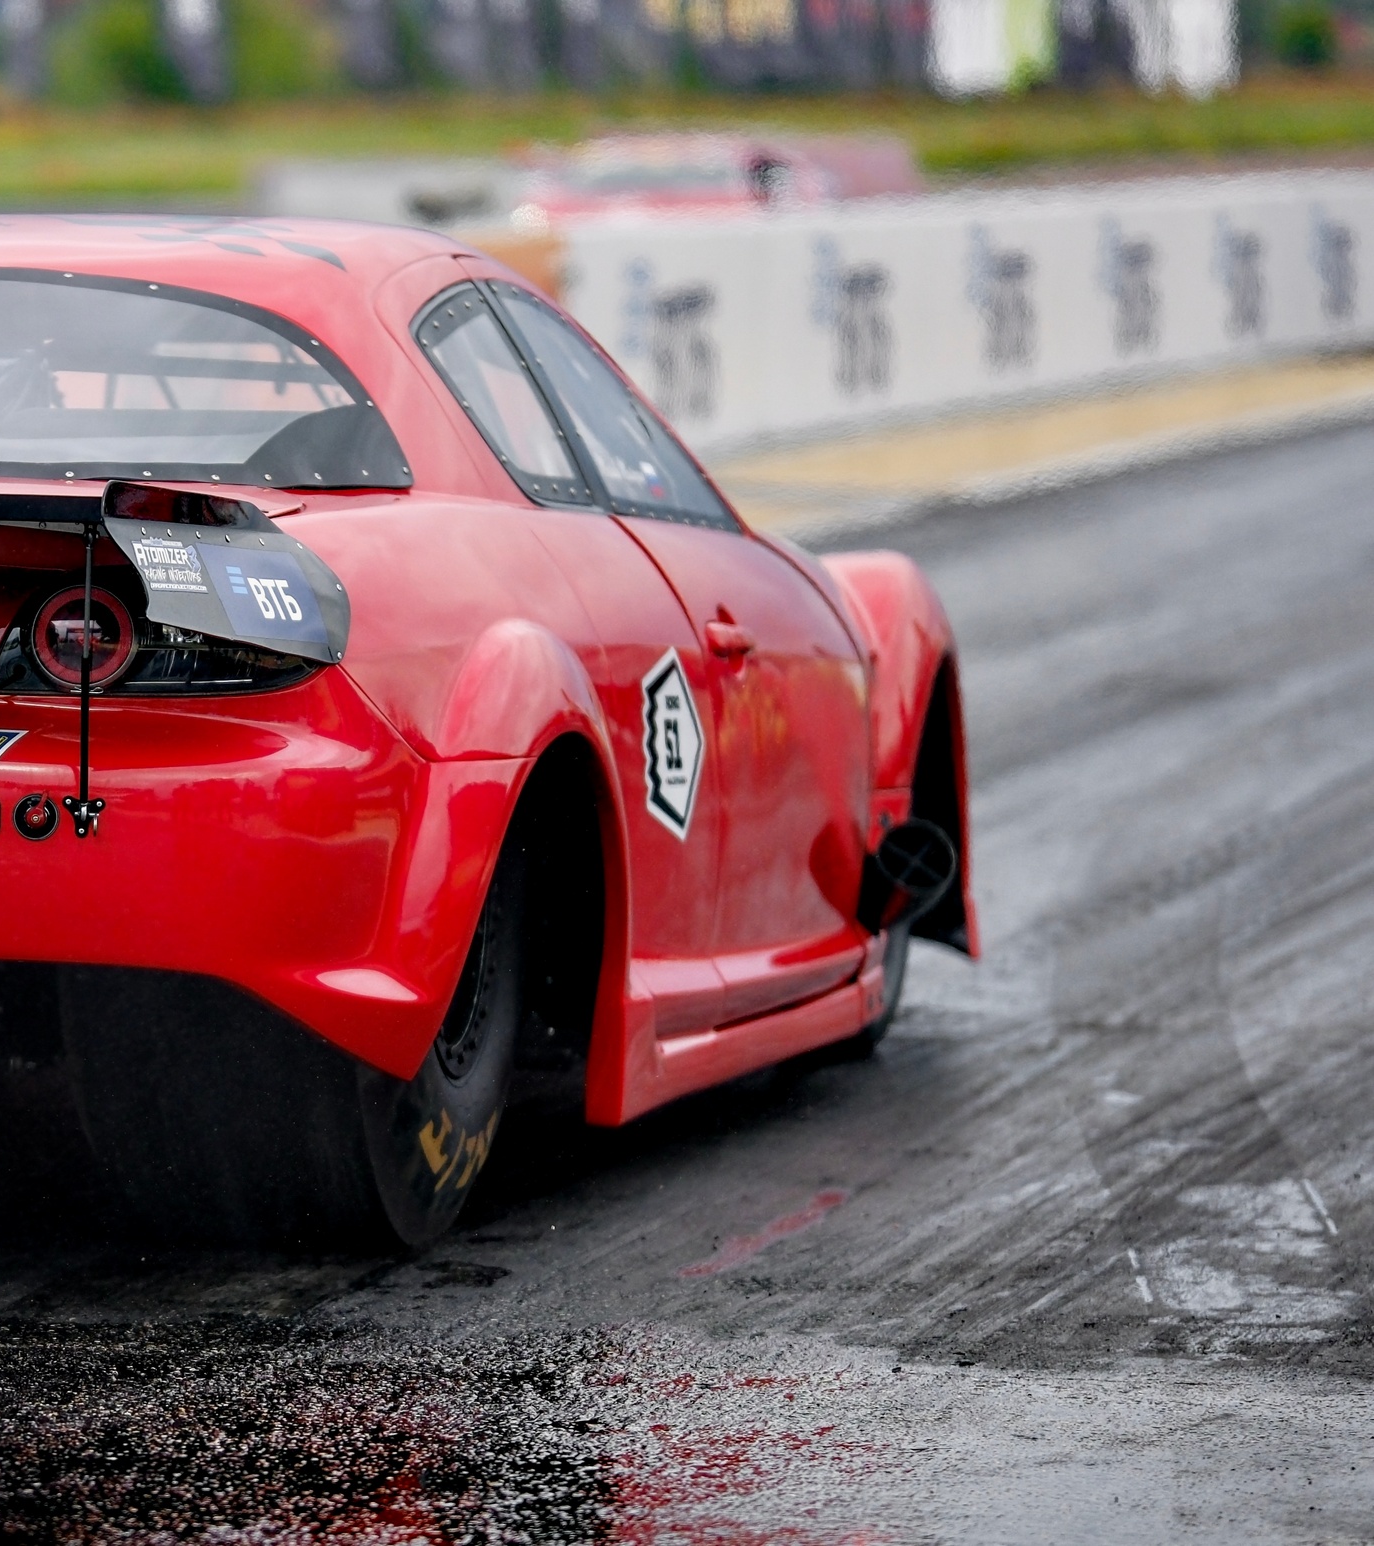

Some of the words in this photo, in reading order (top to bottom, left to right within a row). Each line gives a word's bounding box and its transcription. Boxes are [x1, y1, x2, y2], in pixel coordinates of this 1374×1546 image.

[133, 543, 192, 568] ATOMIZER
[143, 567, 167, 581] RACING
[168, 568, 202, 583] INJECTORS
[246, 577, 303, 621] ВТБ
